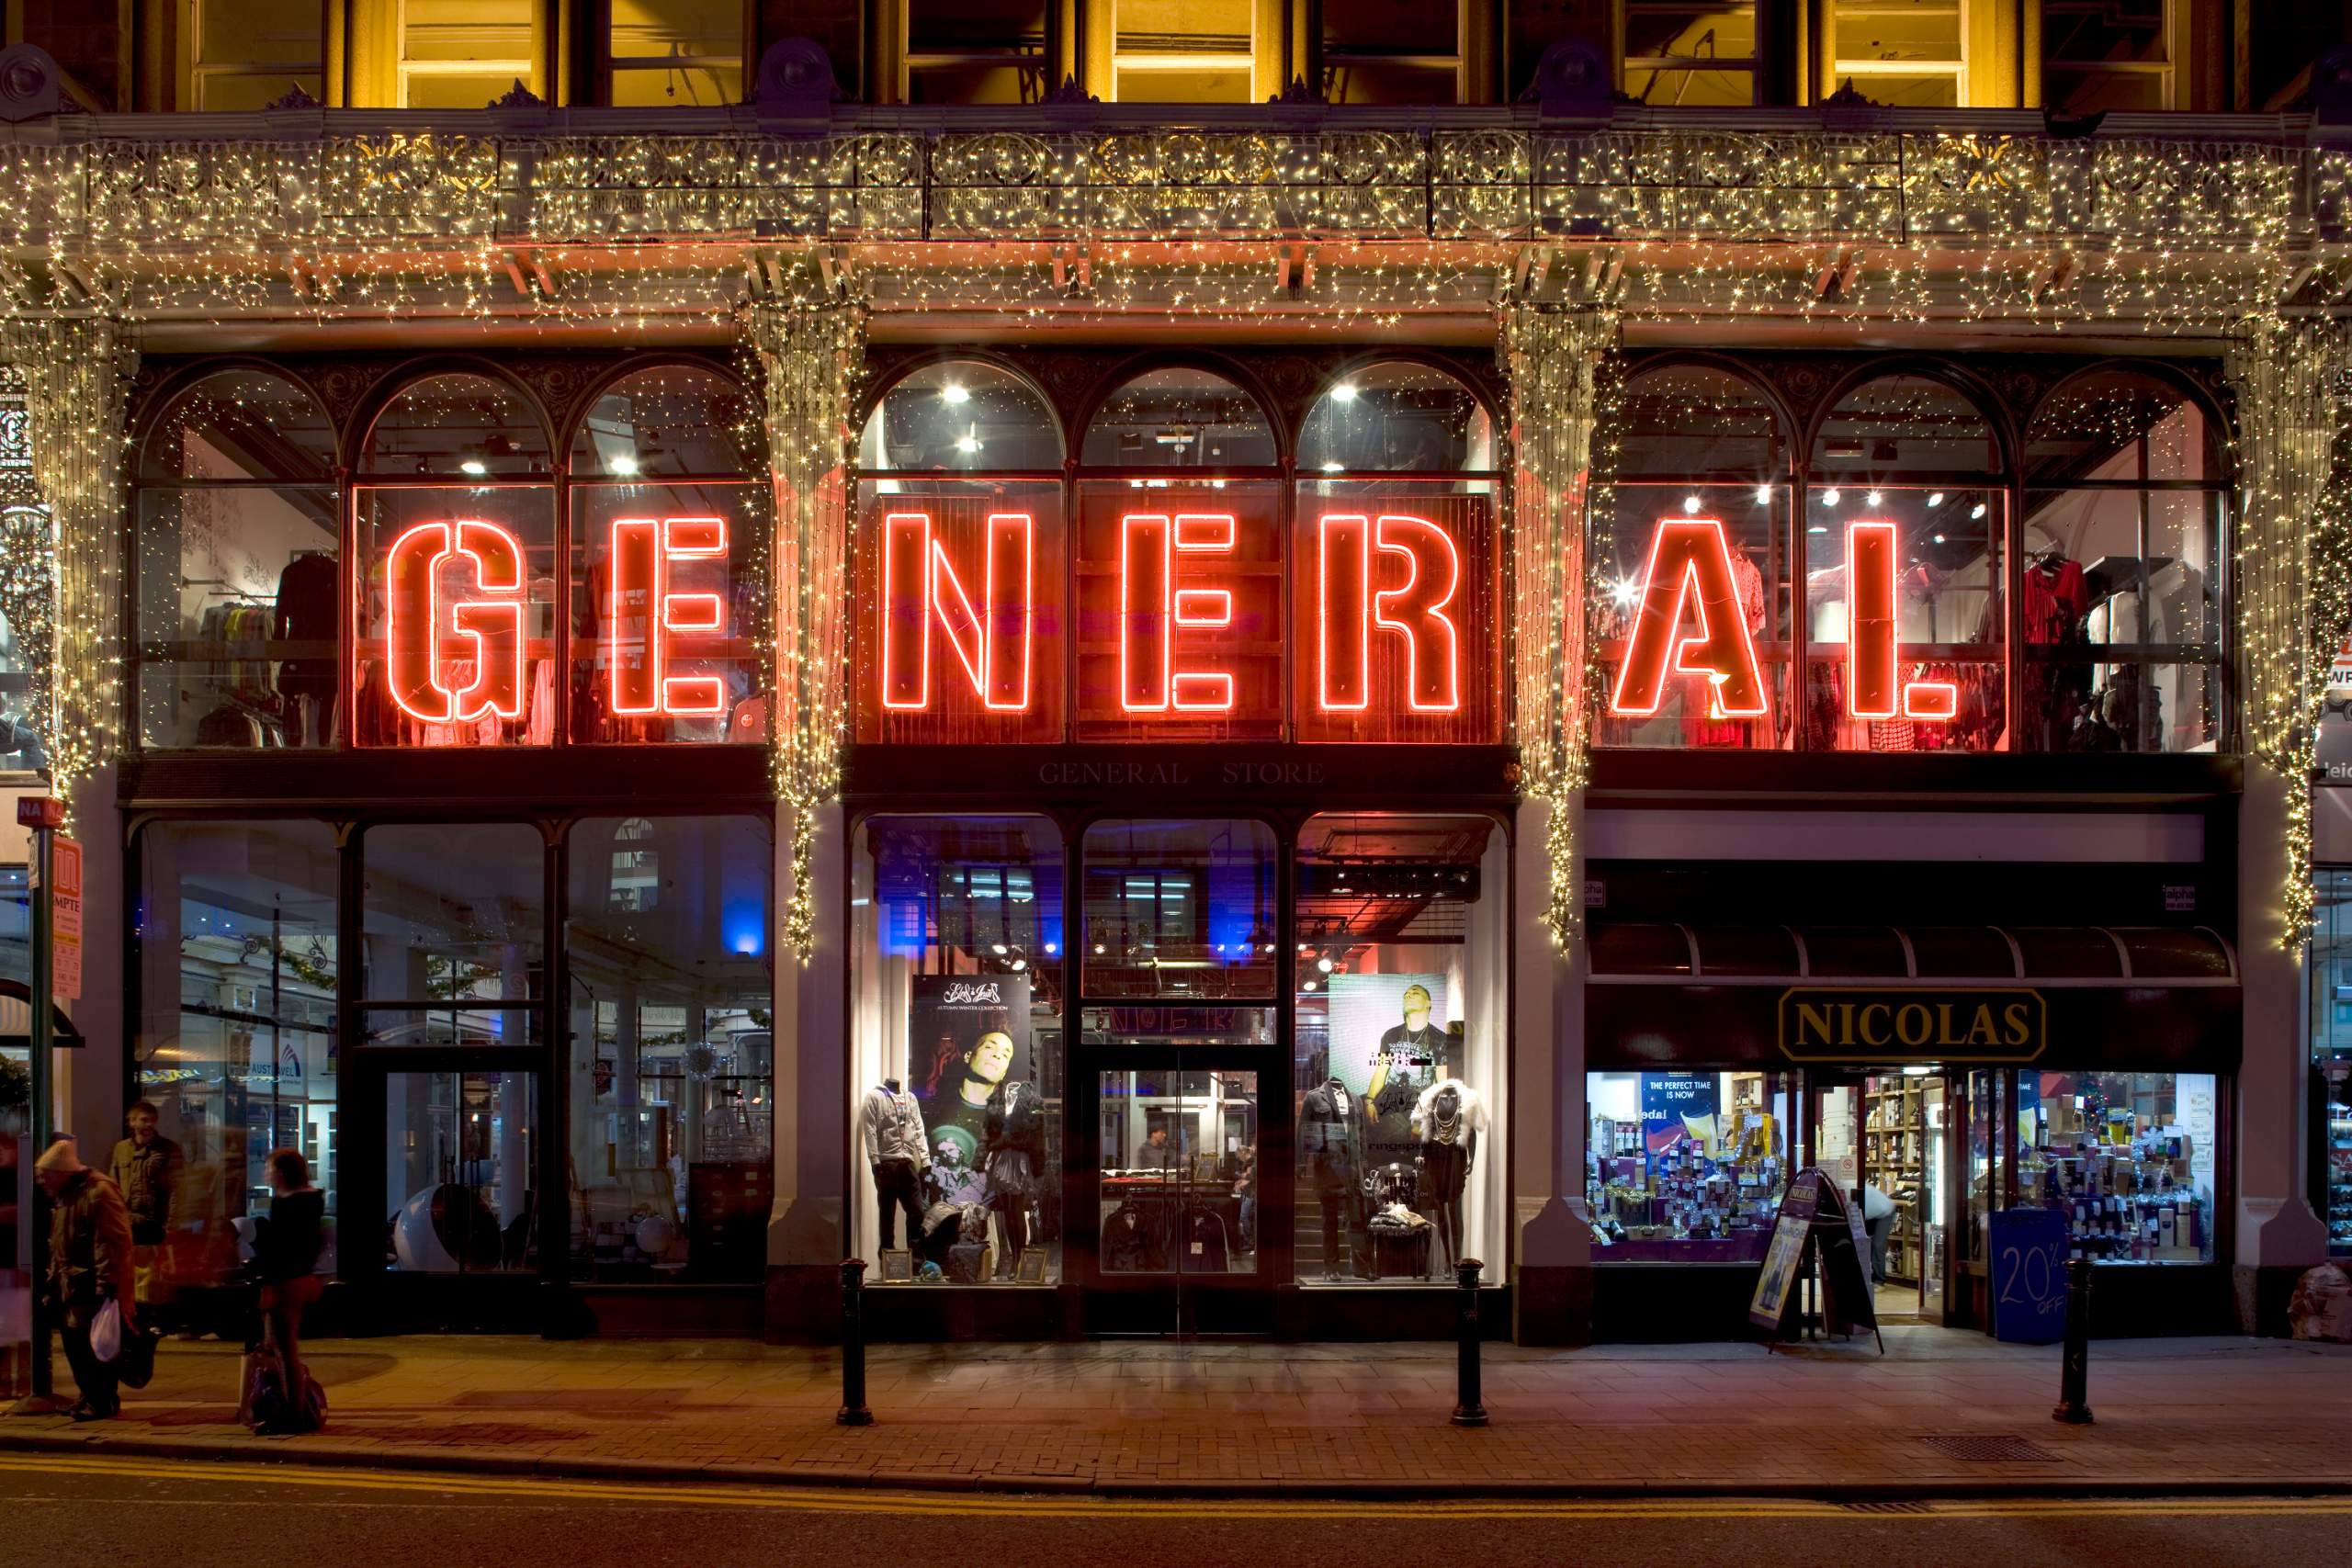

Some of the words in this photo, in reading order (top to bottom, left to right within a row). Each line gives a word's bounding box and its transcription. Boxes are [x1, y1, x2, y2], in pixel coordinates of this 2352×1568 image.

[384, 513, 1960, 726] GENERAL
[1038, 761, 1190, 785] GENERAL
[1222, 761, 1325, 785] STORE
[20, 802, 41, 817] NA
[2166, 888, 2195, 902] alpha
[53, 896, 80, 912] MPTE
[1795, 1003, 2030, 1046] NICOLAS
[1650, 1081, 1663, 1090] THE
[1665, 1081, 1693, 1090] PERFECT
[1694, 1081, 1712, 1089] TIME
[1667, 1091, 1674, 1100] IS
[1675, 1091, 1695, 1100] NOW
[2036, 1294, 2064, 1315] OFF
